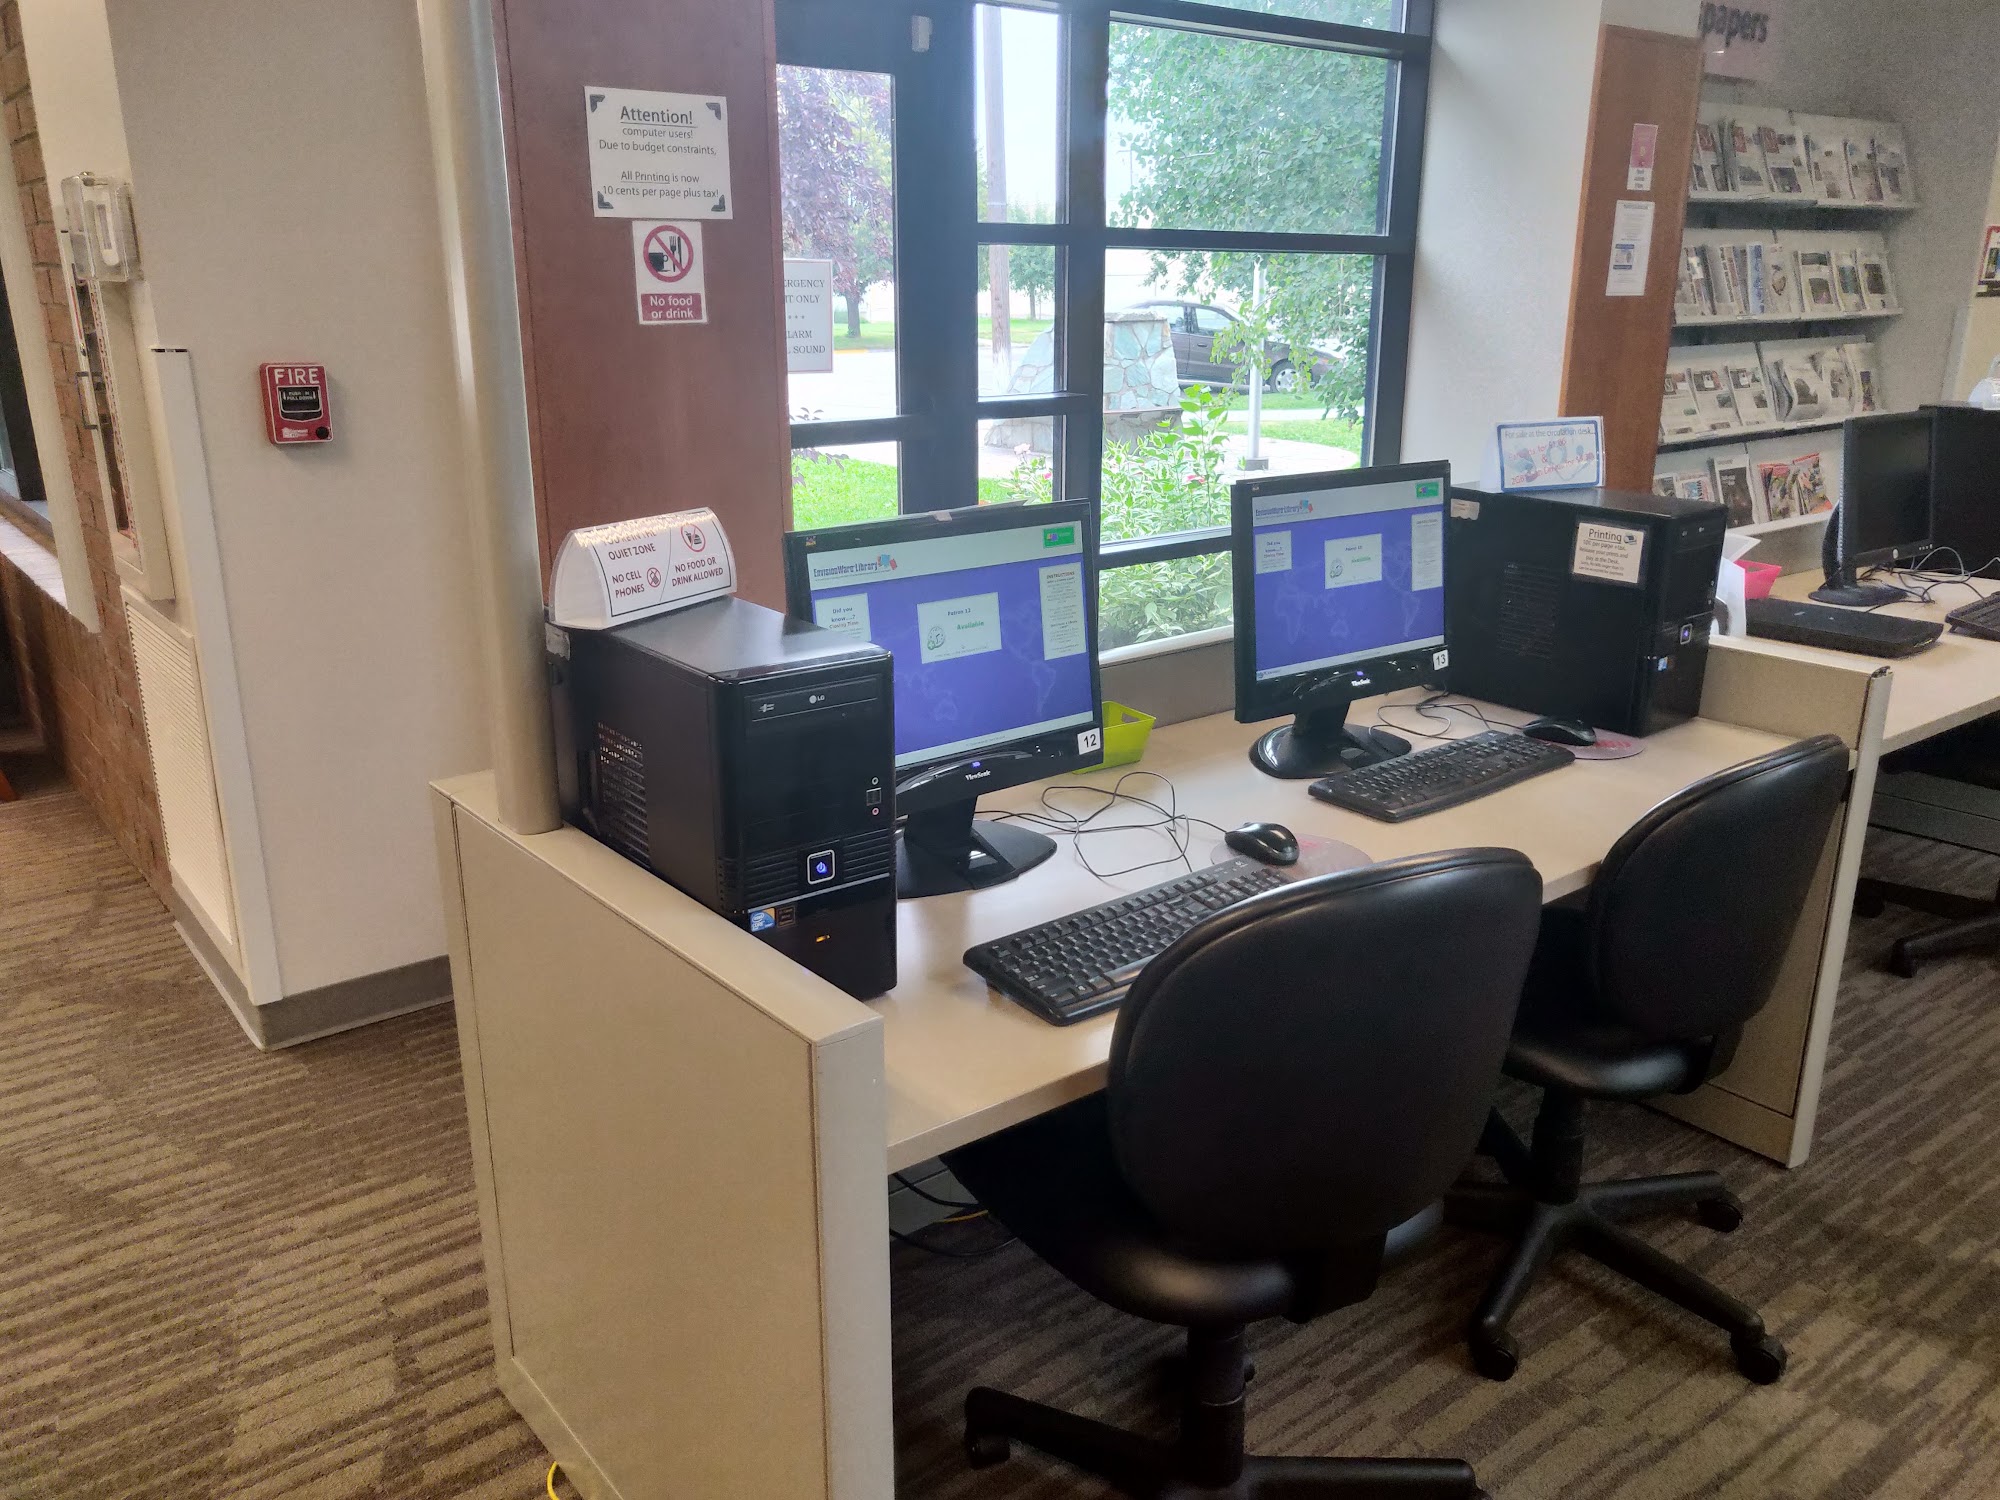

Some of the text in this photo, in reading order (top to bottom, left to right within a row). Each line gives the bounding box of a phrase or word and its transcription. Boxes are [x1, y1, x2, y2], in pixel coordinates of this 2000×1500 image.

[1699, 2, 1769, 48] papers
[620, 106, 693, 125] Attention!
[622, 127, 693, 139] computer users!
[599, 139, 717, 156] Due to budget constraints,
[620, 171, 700, 184] All Printing is now
[603, 185, 719, 198] 10 cents per page plus tax!
[650, 295, 693, 307] No food
[796, 295, 820, 304] ONLY
[651, 308, 694, 320] or drink
[786, 330, 813, 339] LARM
[793, 345, 826, 354] SOUND
[274, 368, 320, 385] FIRE
[1536, 429, 1546, 437] the
[1588, 528, 1622, 544] Printing
[608, 543, 657, 561] QUIET ZONE
[674, 556, 717, 573] NO FOOD OR
[855, 562, 878, 573] Library
[612, 569, 642, 585] NO CELL
[671, 567, 724, 587] DRINK ALLOWED
[615, 583, 645, 599] PHONES
[957, 621, 985, 631] Available
[1435, 653, 1446, 666] 13
[817, 694, 826, 702] LG
[1083, 733, 1097, 748] 12
[965, 770, 992, 781] ViewSonic
